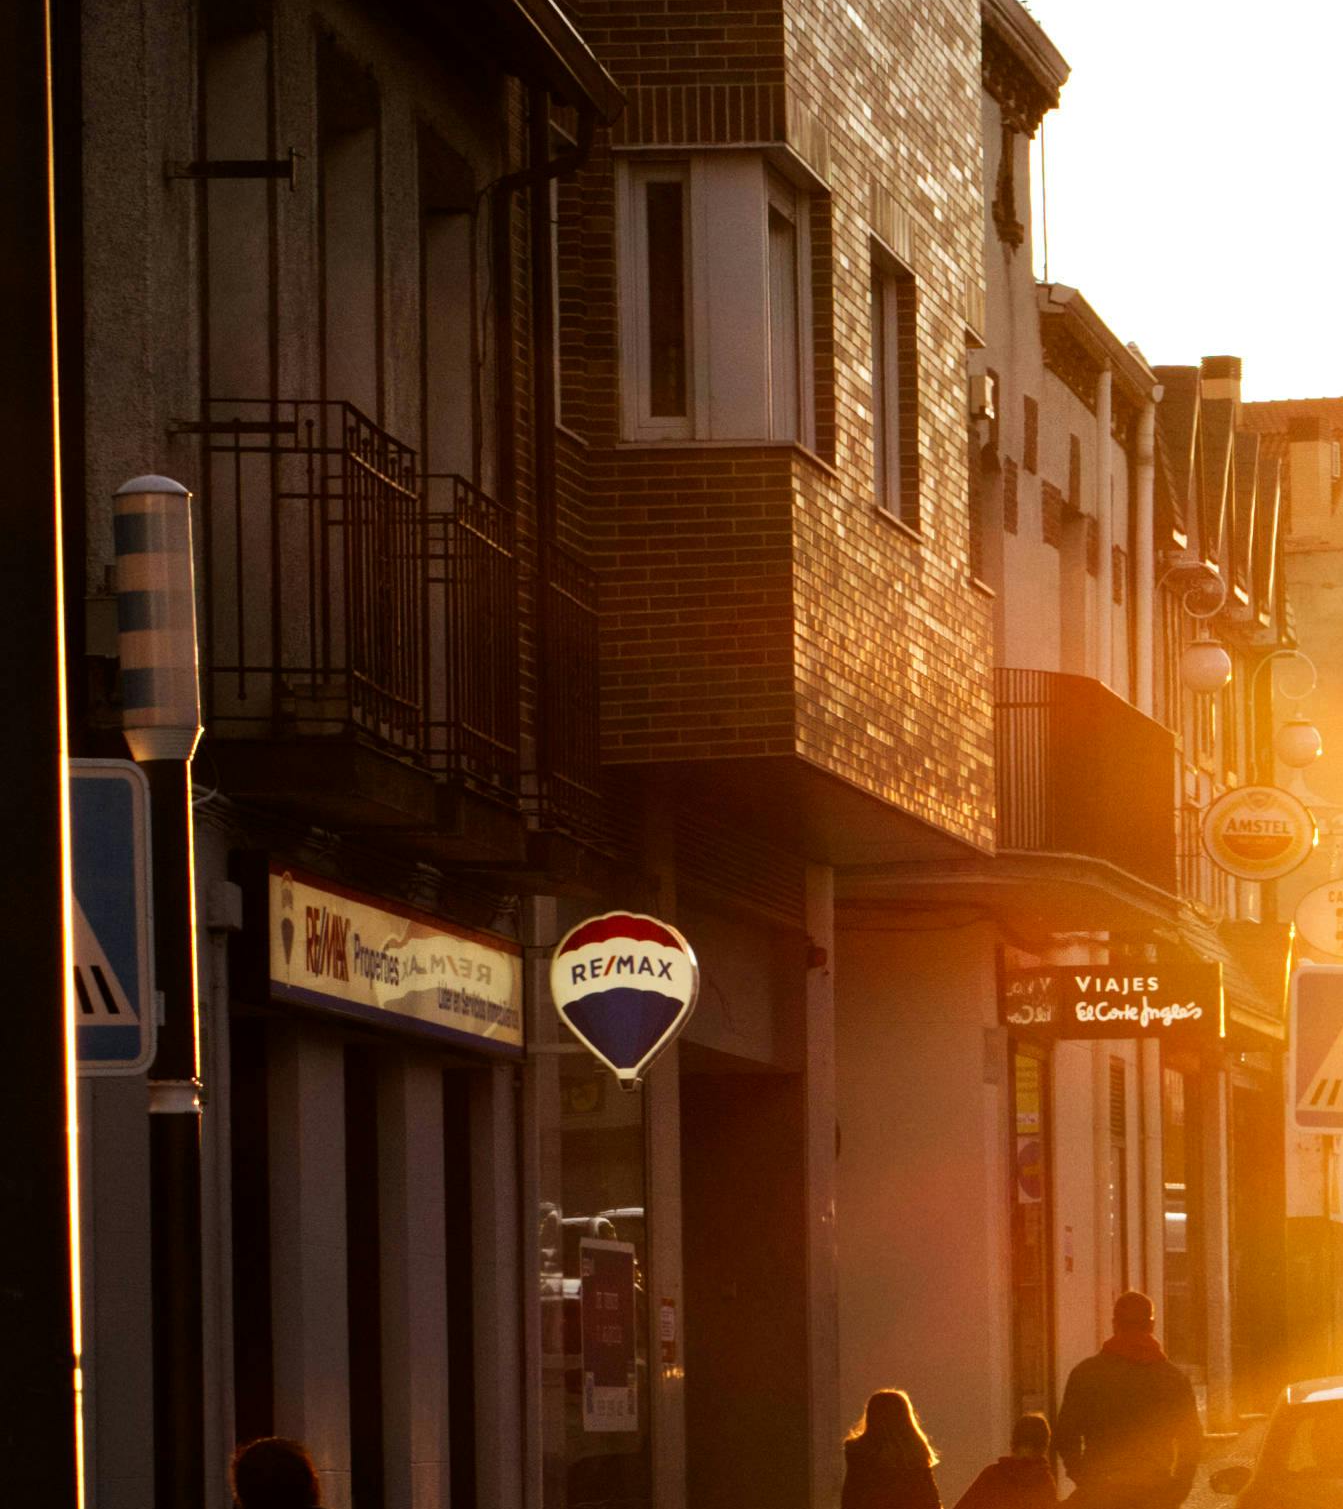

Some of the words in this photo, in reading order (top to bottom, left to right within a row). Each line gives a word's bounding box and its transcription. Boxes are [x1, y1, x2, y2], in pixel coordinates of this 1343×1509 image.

[1225, 818, 1291, 834] AMSTEL
[305, 905, 350, 982] RE/MAX
[353, 933, 400, 990] Properties
[571, 955, 673, 985] RE/MAX
[1074, 976, 1160, 995] VIAJES
[1075, 1001, 1096, 1022] El
[1095, 1000, 1139, 1023] Corte
[1139, 996, 1203, 1028] Inglés
